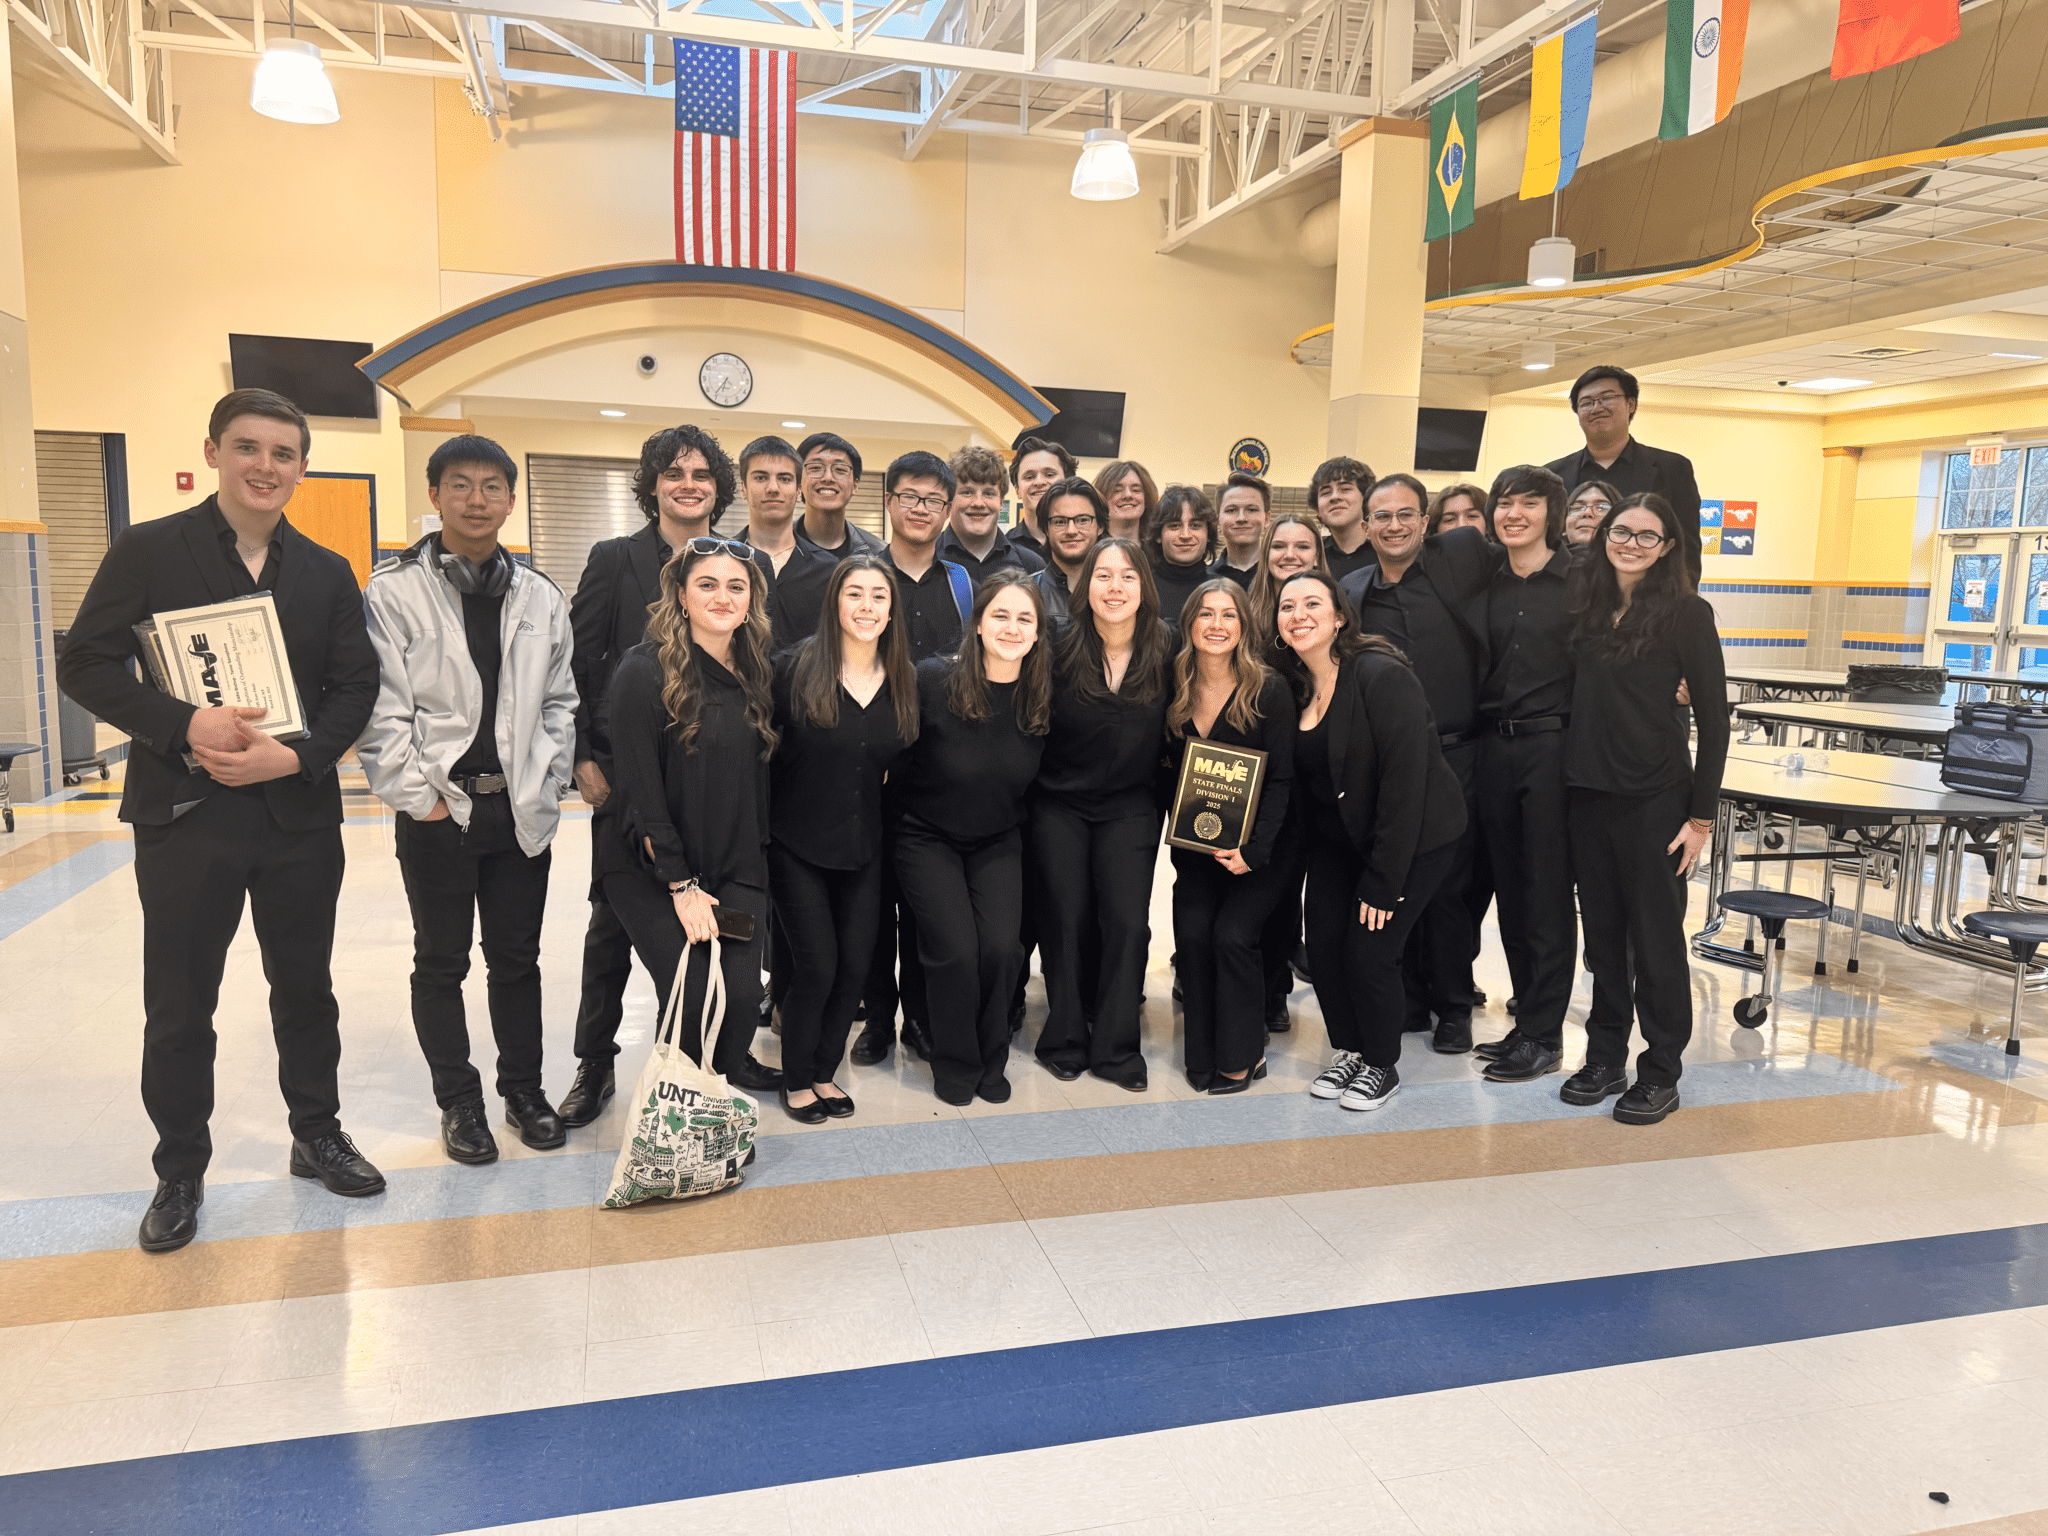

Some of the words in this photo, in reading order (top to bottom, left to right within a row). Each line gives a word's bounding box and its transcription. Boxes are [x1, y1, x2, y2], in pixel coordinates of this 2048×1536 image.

[1974, 446, 1998, 465] EXIT
[226, 621, 238, 651] Musicianship
[223, 642, 231, 663] Saxophone
[234, 651, 246, 680] Outstanding
[1193, 778, 1215, 789] STATE
[1216, 784, 1243, 794] FINALS
[1196, 789, 1229, 801] DIVISION
[1206, 801, 1221, 809] 2025
[658, 1081, 700, 1107] UNT
